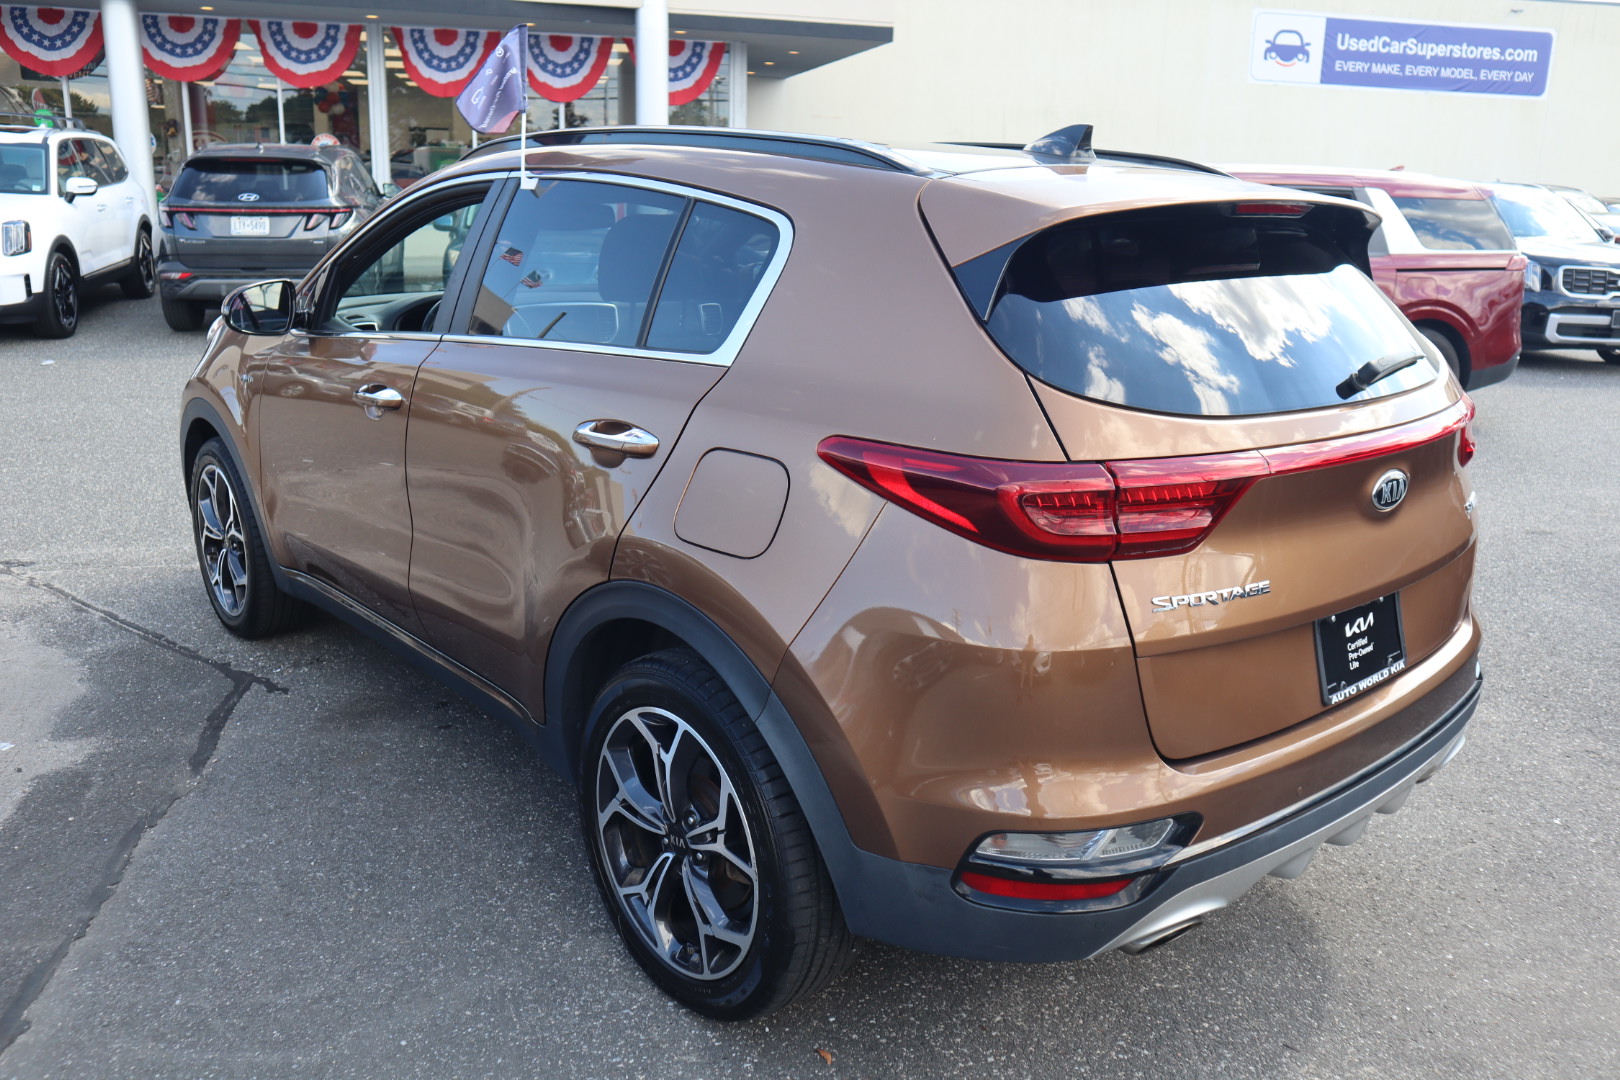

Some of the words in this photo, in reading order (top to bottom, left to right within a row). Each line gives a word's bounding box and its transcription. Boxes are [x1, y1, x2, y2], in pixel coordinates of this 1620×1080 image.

[1336, 32, 1538, 62] UsedCarSuperstores.com
[1334, 60, 1370, 73] EVERY
[1371, 62, 1404, 76] MAKE,
[1405, 65, 1440, 77] EVERY
[1440, 67, 1477, 80] MODEL,
[1480, 70, 1513, 82] EVERY
[1514, 71, 1535, 83] DAY
[1380, 478, 1407, 505] KIA
[1151, 580, 1271, 613] SPORTAGE
[1345, 611, 1375, 638] KIA
[1347, 635, 1368, 651] Certified
[1348, 643, 1374, 661] Pre-Owned
[1331, 685, 1357, 704] AUTO
[1358, 669, 1389, 691] WORLD
[1391, 660, 1406, 675] KIA
[669, 834, 686, 849] KIA
